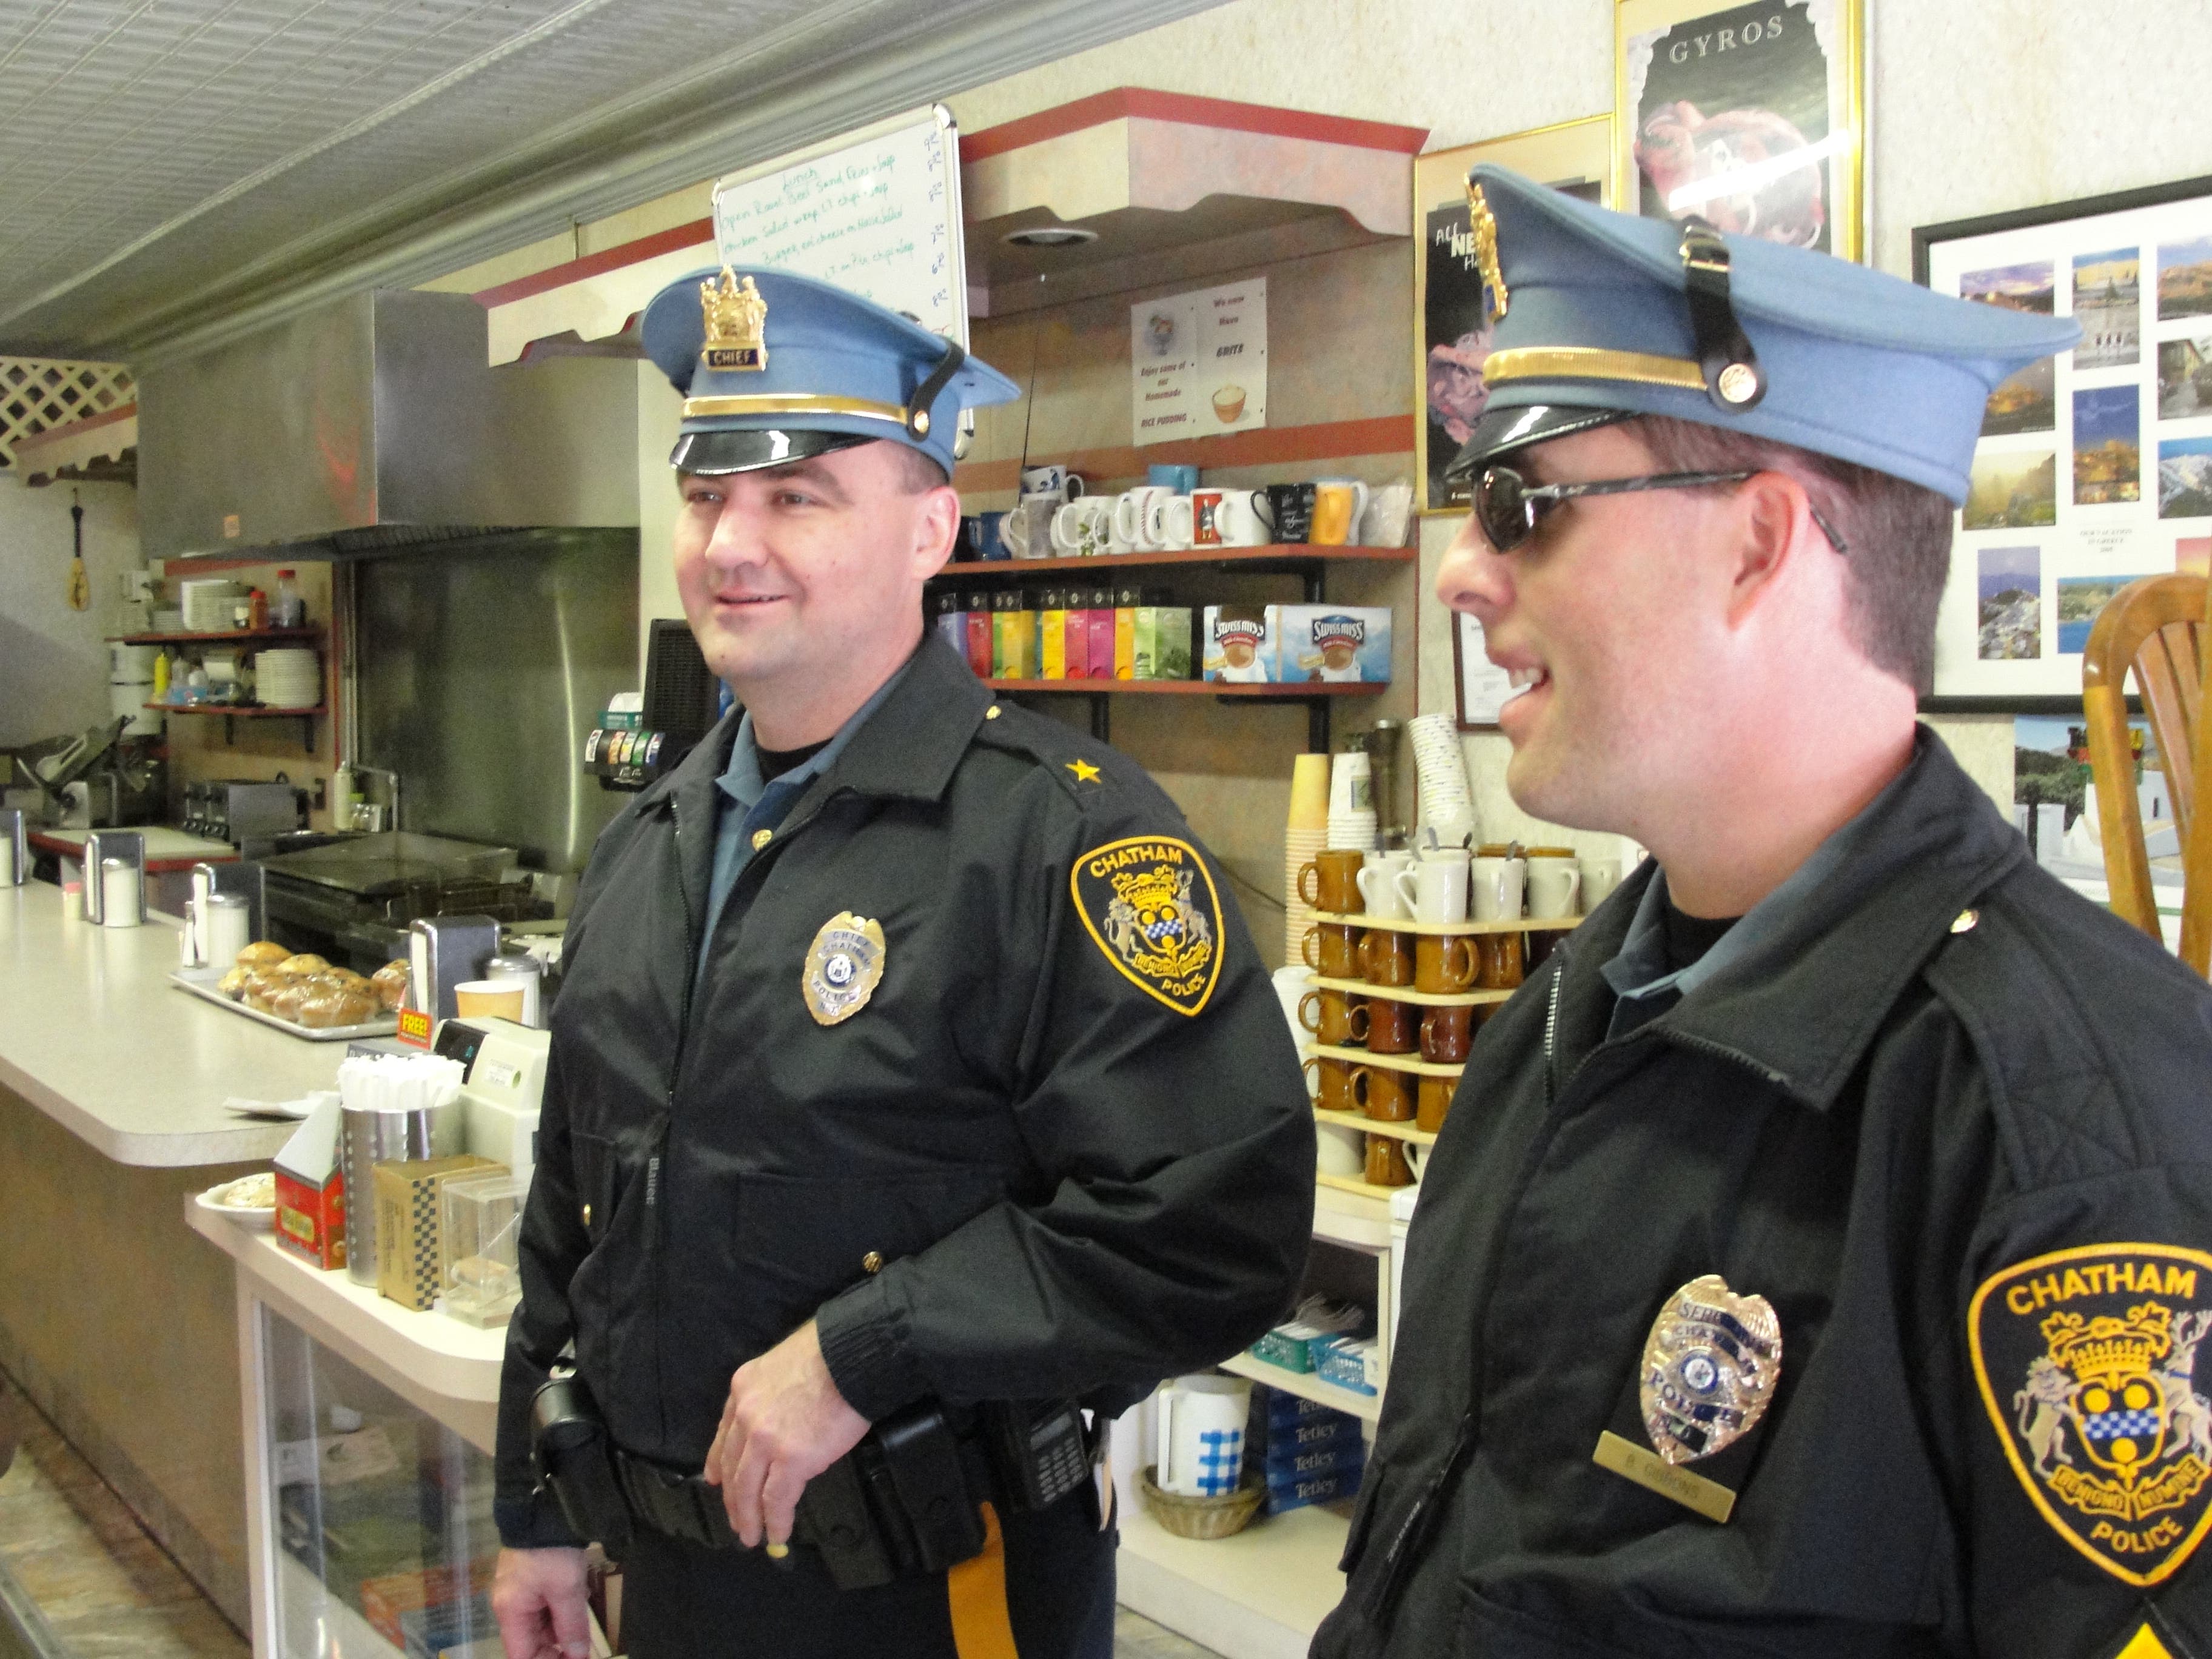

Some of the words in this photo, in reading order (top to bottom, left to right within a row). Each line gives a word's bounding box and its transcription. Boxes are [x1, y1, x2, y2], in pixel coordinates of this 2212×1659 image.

[1669, 15, 1783, 64] GYROS
[1450, 232, 1477, 258] NE
[714, 350, 751, 364] CHIEF
[1145, 388, 1181, 401] Homemade
[1141, 417, 1155, 427] RICE
[1156, 413, 1187, 426] PUDDING
[1090, 845, 1184, 878] CHATHAM
[833, 931, 870, 947] CHIEF
[813, 980, 857, 1002] POLICE
[1162, 972, 1207, 996] POLICE
[2005, 1262, 2197, 1315] CHATHAM
[1295, 1424, 1338, 1444] Tetley
[1294, 1452, 1336, 1472] Tetley
[1295, 1478, 1338, 1500] Tetley
[2090, 1515, 2184, 1553] POLICE
